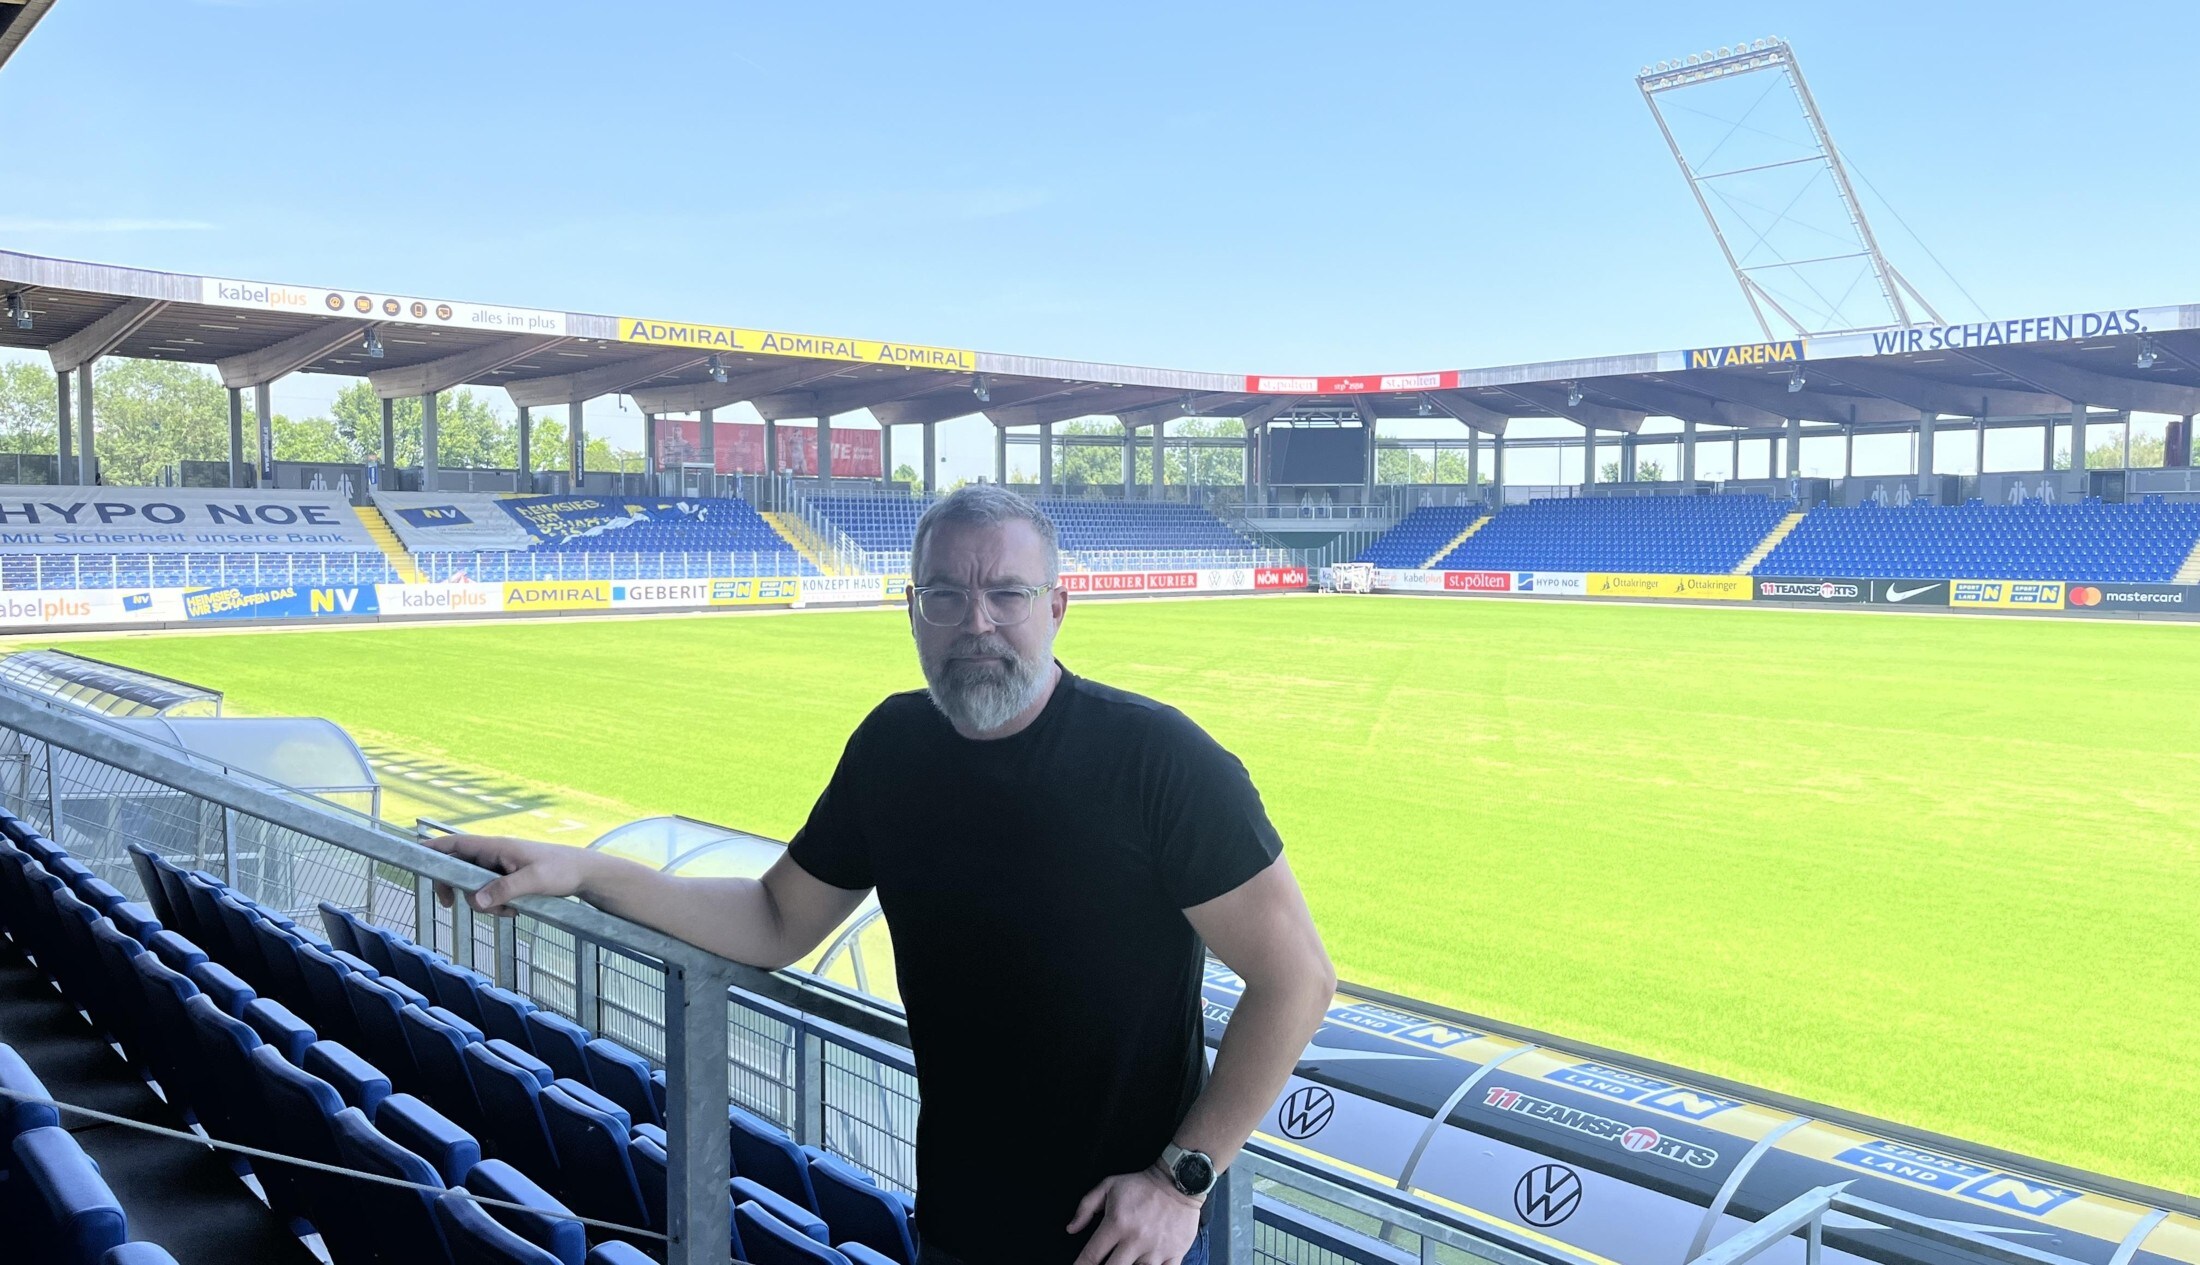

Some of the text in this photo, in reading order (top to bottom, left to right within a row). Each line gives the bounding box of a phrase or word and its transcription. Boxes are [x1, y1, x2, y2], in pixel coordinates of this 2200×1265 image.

[218, 282, 307, 308] kabelplus
[471, 310, 556, 329] alles im plus
[1873, 309, 2148, 354] WIR SCHAFFEN DAS.
[629, 321, 970, 368] ADMIRAL ADMIRAL ADMIRAL
[1692, 342, 1797, 368] NV ARENA
[0, 503, 341, 525] HYPO NOE
[422, 509, 456, 519] NV
[2, 533, 352, 544] Mit Sicherheit unsere Bank.
[802, 578, 880, 591] KONZEPT HAUS
[1094, 576, 1143, 589] KURIER
[1149, 575, 1196, 587] KURIER
[1257, 570, 1303, 584] NÖN NÖN
[1403, 571, 1442, 585] kabelplus
[1449, 573, 1505, 589] st.pölten
[1536, 578, 1580, 587] HYPO NOE
[1613, 577, 1738, 591] Ottakringer Ottakringer
[133, 595, 150, 604] NV
[310, 588, 359, 613] NV
[402, 589, 487, 609] kabelplus
[507, 587, 608, 604] ADMIRAL
[629, 585, 707, 600] GEBERIT
[2106, 590, 2183, 603] mastercard
[188, 587, 297, 617] WIR SCHAFFEN DAS.
[1338, 1013, 1387, 1028] LAND
[1360, 1005, 1420, 1024] SPORT
[1565, 1074, 1626, 1094] LAND
[1587, 1066, 1661, 1088] SPORT
[1879, 1144, 1976, 1172] SPORT
[1860, 1156, 1939, 1181] LAND
